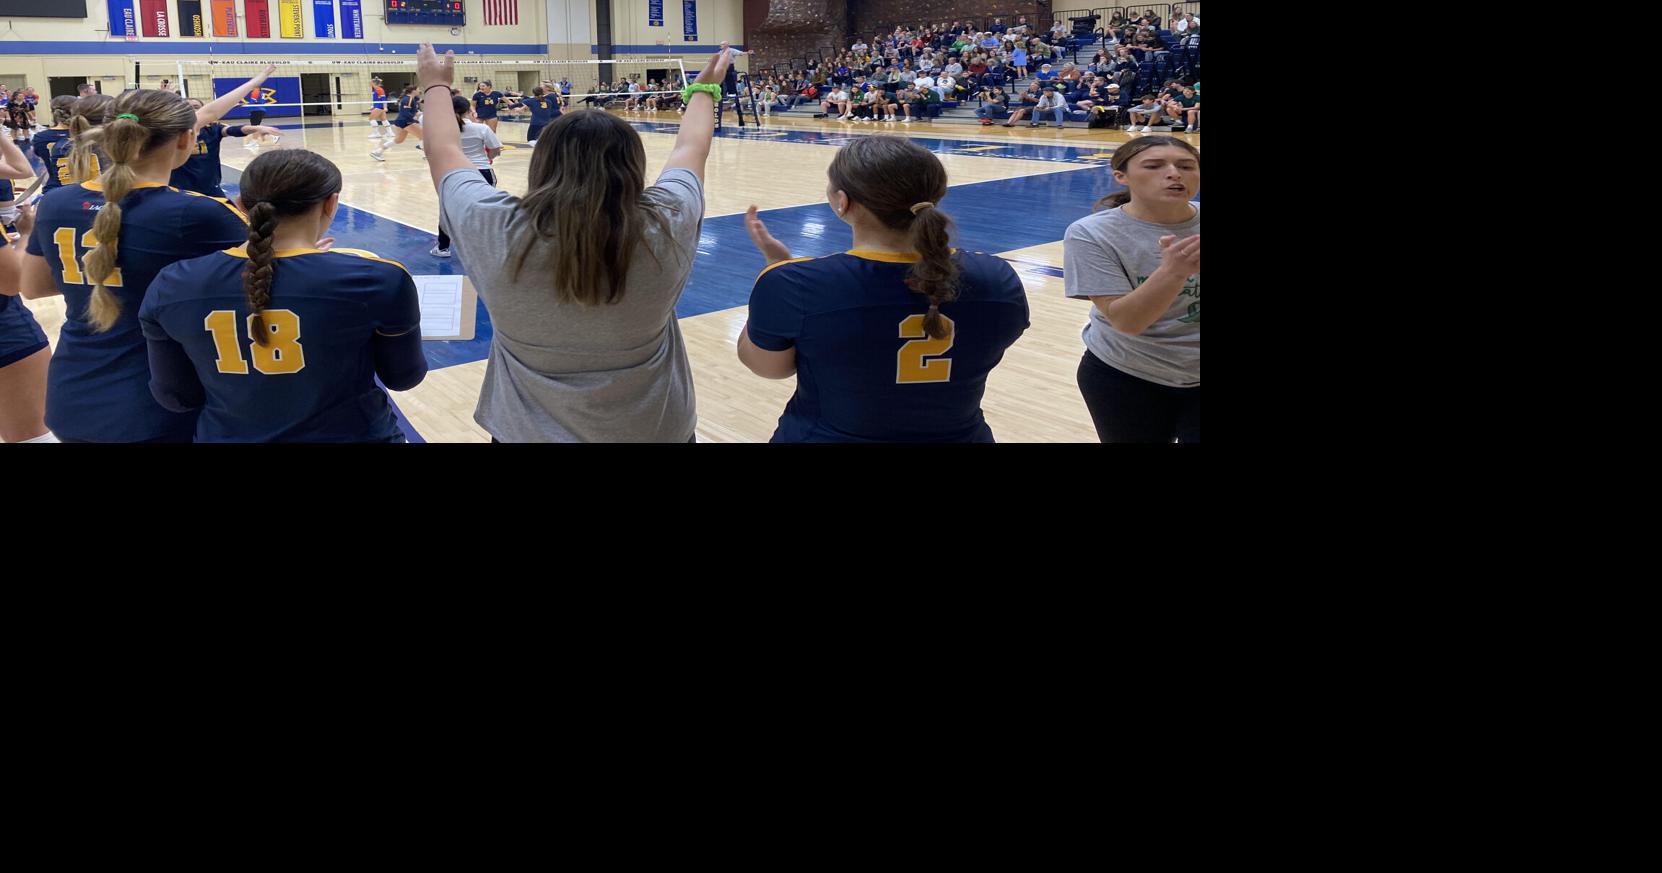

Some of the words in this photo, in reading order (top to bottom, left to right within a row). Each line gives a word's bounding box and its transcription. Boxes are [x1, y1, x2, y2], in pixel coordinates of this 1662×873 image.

[124, 8, 133, 18] EAU
[352, 9, 361, 38] WHITEWATER
[125, 18, 136, 37] CLAIRE
[158, 18, 167, 37] CROSSE
[193, 15, 201, 38] OSHKOSH
[204, 309, 306, 375] 18
[896, 313, 955, 384] 2
